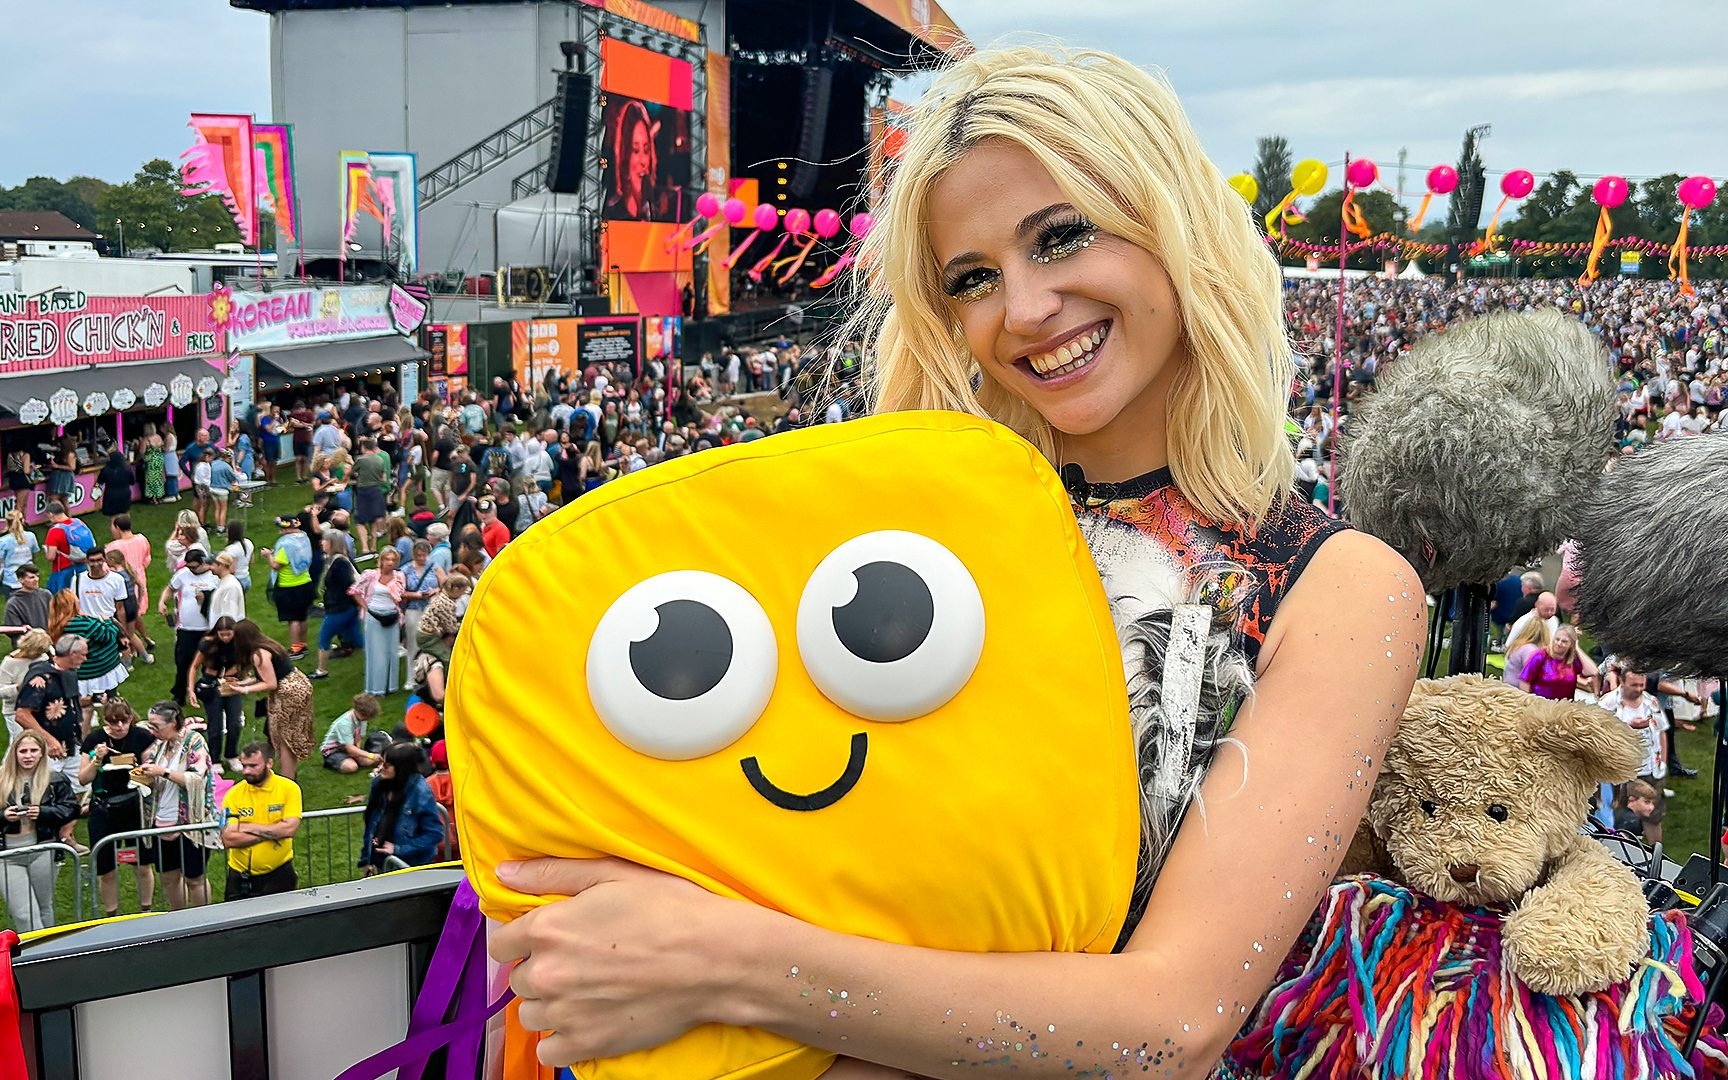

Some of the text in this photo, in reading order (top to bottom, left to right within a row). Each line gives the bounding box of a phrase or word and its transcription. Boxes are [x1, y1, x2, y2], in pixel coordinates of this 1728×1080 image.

[40, 291, 86, 312] BASED
[231, 292, 311, 337] KOREAN
[0, 307, 215, 361] RIED CHICK'N & FRIES
